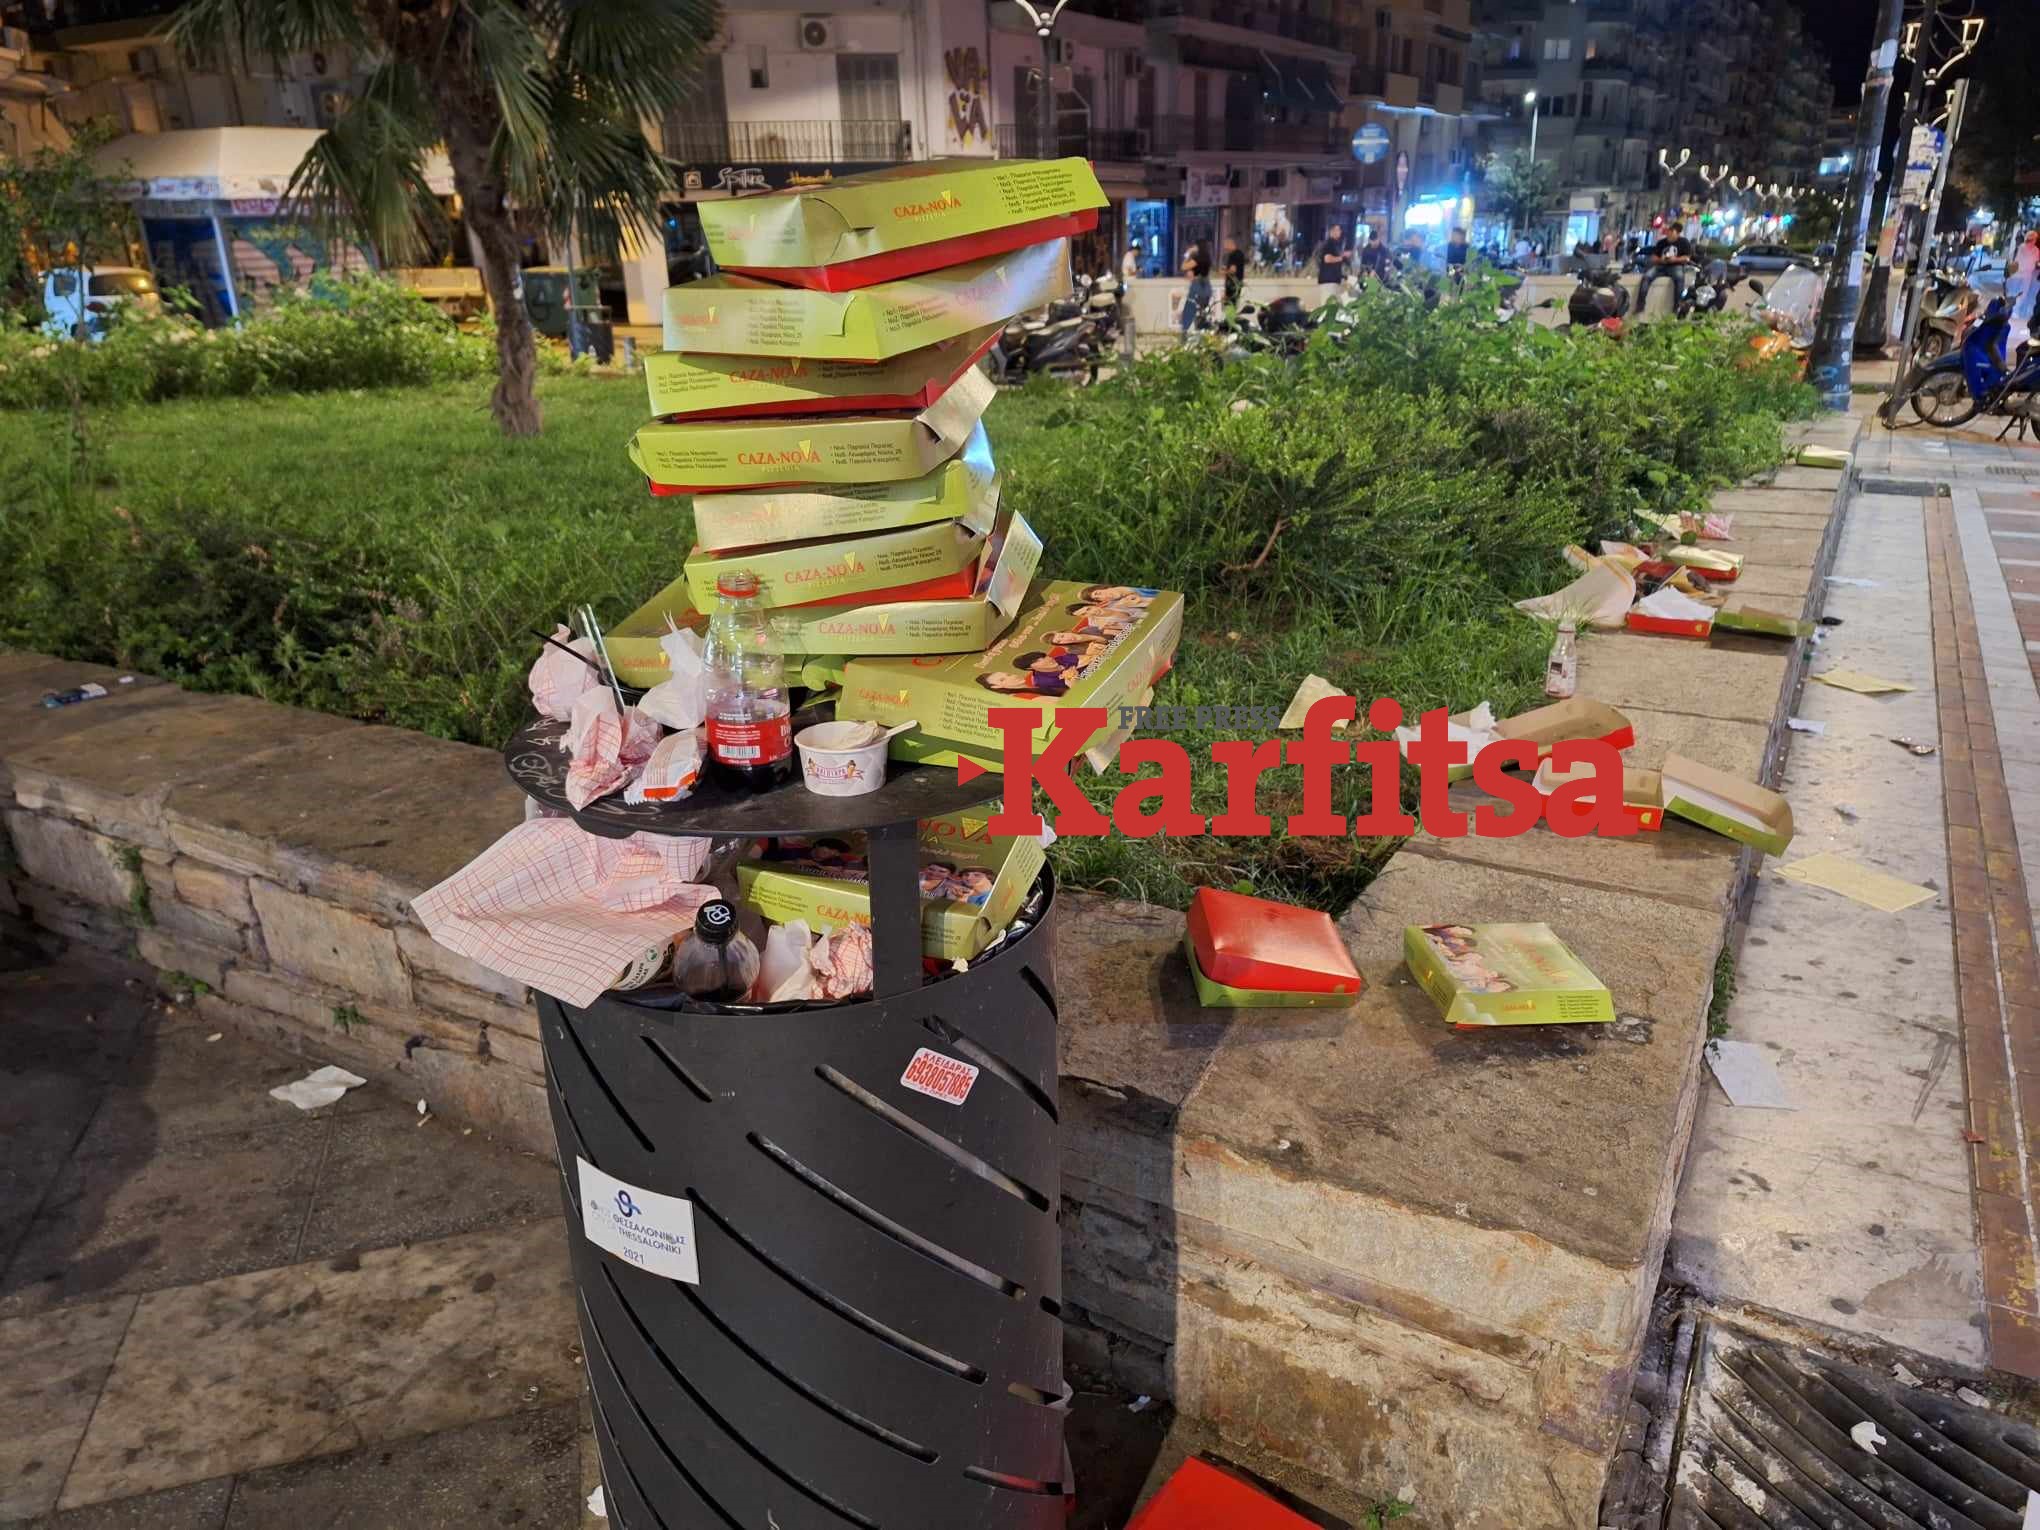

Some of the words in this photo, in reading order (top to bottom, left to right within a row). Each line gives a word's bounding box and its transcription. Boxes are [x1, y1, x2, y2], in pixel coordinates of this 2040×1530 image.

[737, 446, 821, 465] CAZA-NOVA
[784, 557, 865, 584] CAZA-NOVA
[819, 617, 897, 635] CAZA-NOVA
[618, 1226, 681, 1256] THESSALONIKI
[623, 1246, 645, 1265] 2021
